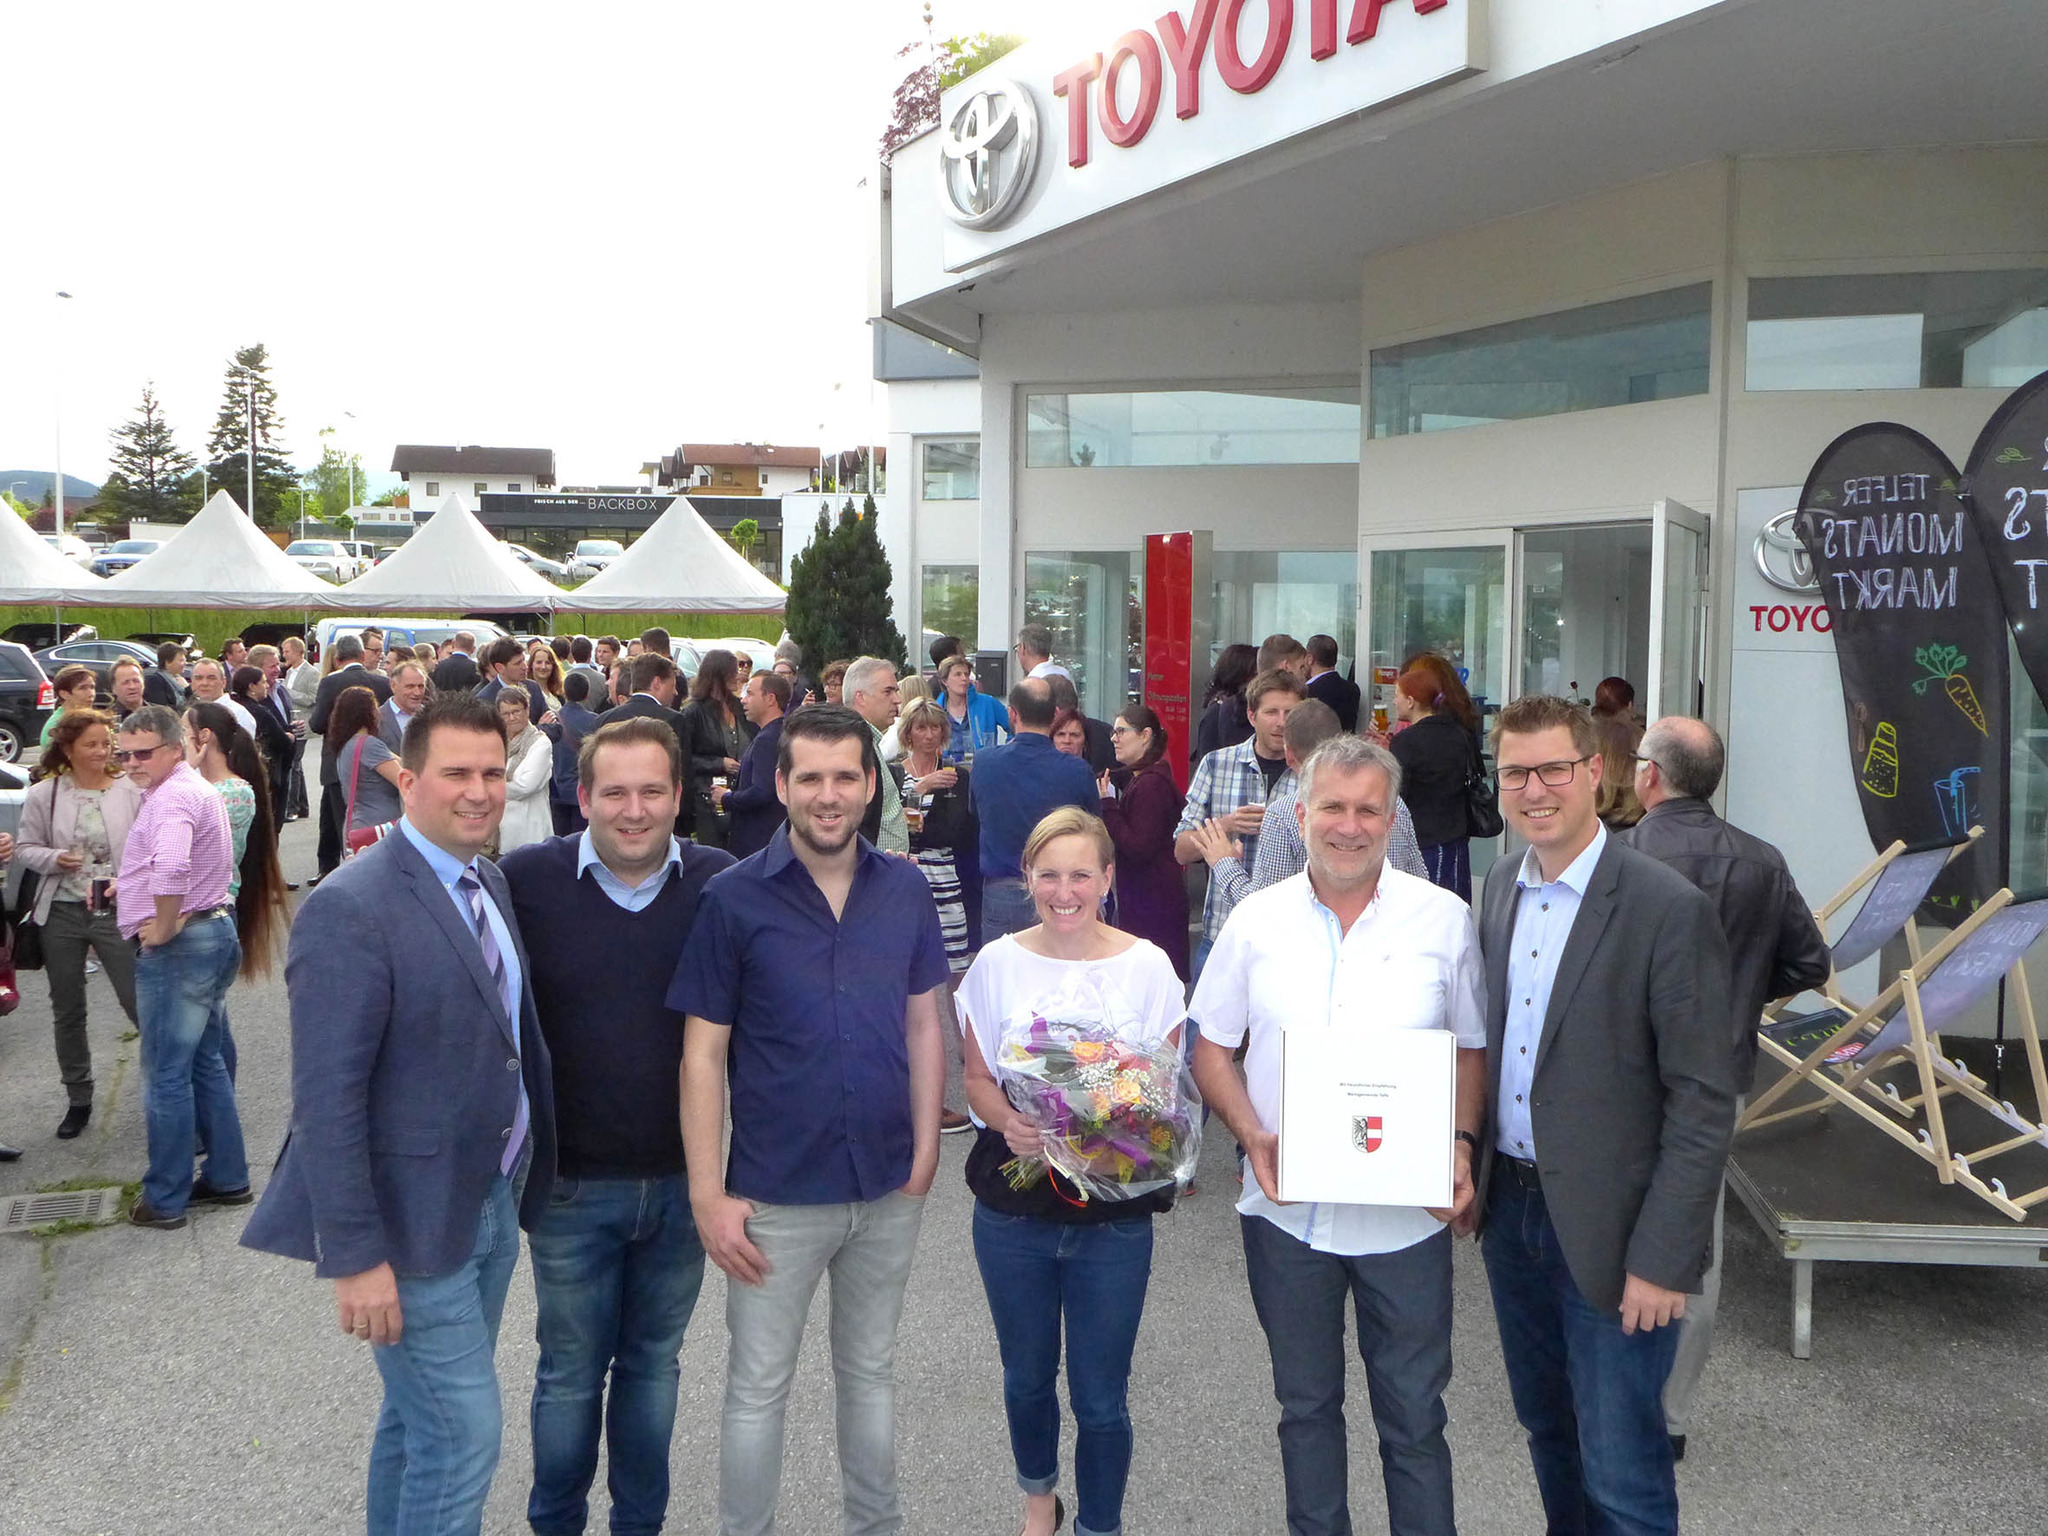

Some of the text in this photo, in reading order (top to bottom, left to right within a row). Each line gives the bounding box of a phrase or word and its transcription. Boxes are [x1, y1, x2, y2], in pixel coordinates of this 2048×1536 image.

[1053, 0, 1448, 169] TOYO
[588, 498, 658, 511] BACKBOX
[1749, 605, 1832, 633] TOYO
